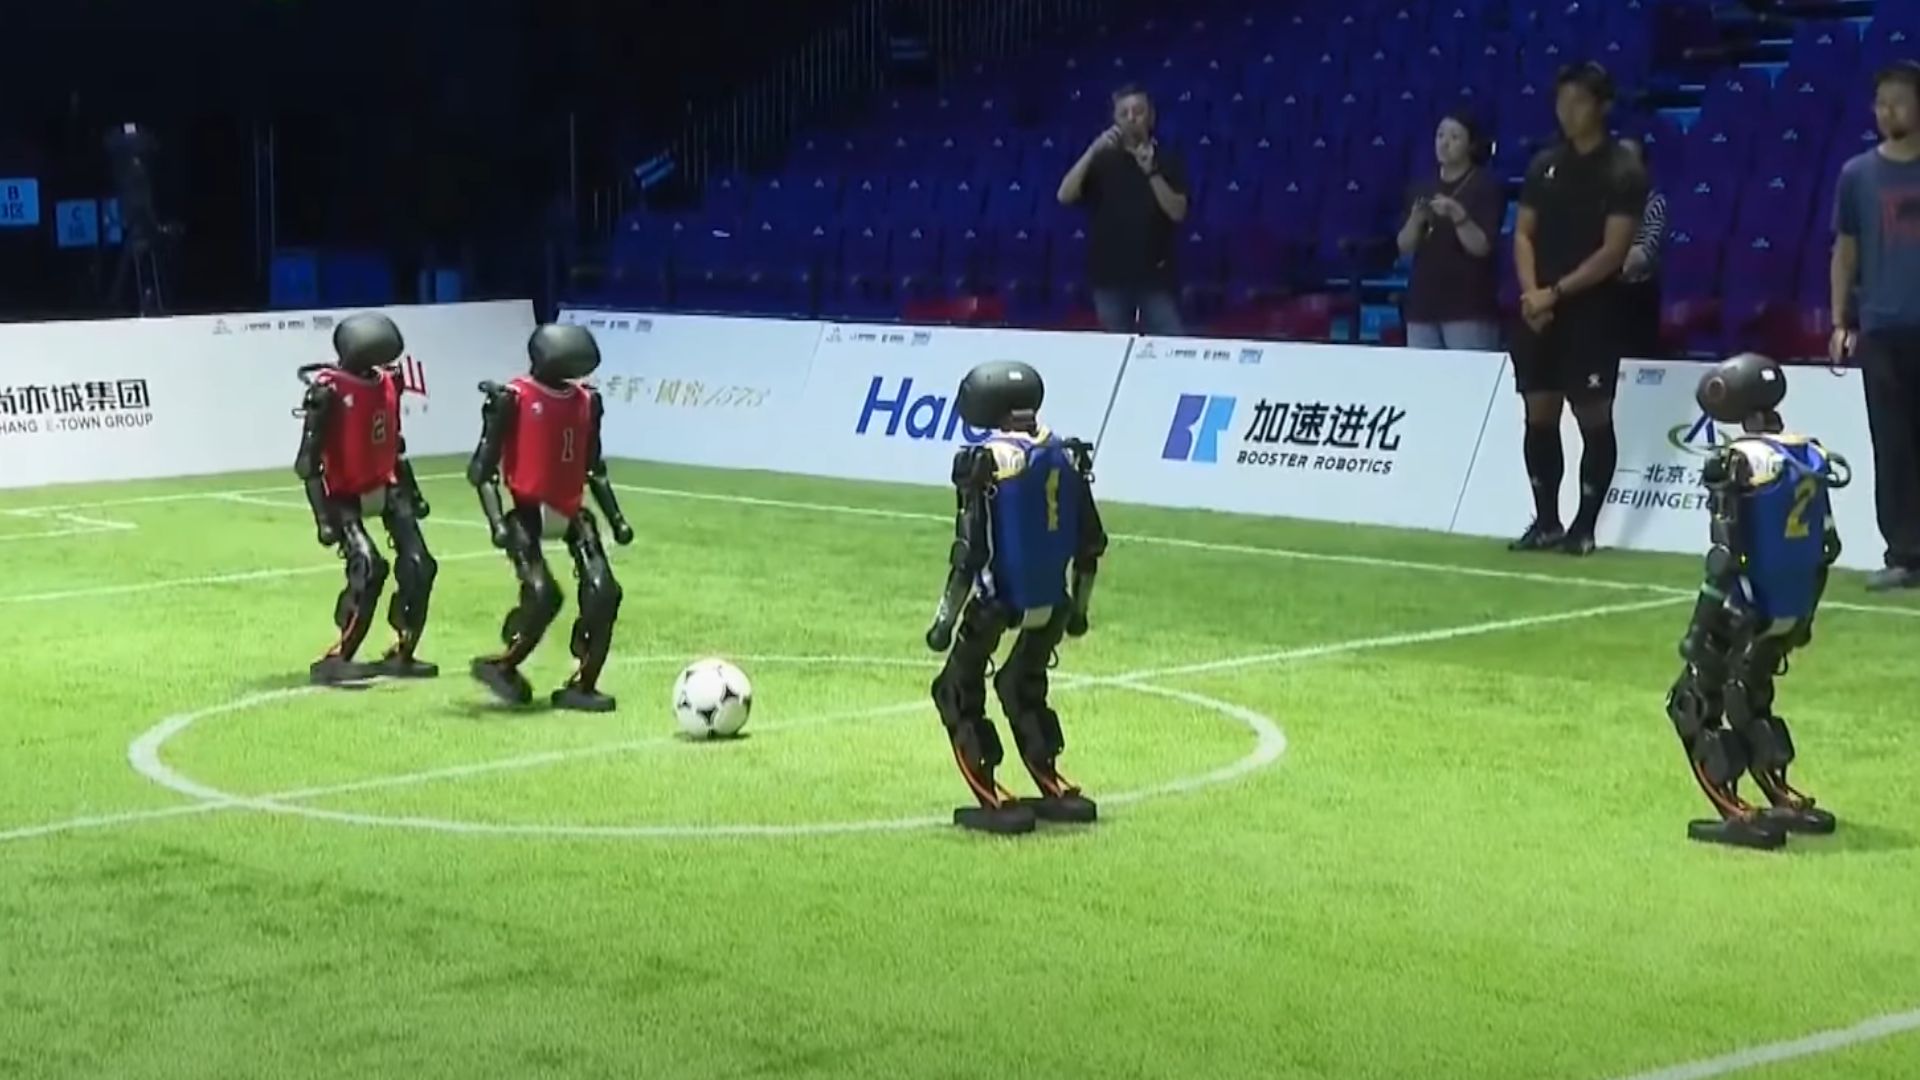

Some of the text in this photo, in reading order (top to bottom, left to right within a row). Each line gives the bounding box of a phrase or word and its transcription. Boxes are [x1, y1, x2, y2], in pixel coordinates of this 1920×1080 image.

[0, 378, 150, 415] 尚亦城集团
[105, 412, 154, 428] GROUP
[371, 411, 387, 444] 2
[1244, 398, 1406, 451] 加速进化
[561, 426, 574, 462] 1
[1236, 450, 1393, 475] BOOSTER ROBOTICS
[1045, 467, 1061, 532] 1
[1784, 475, 1818, 538] 2
